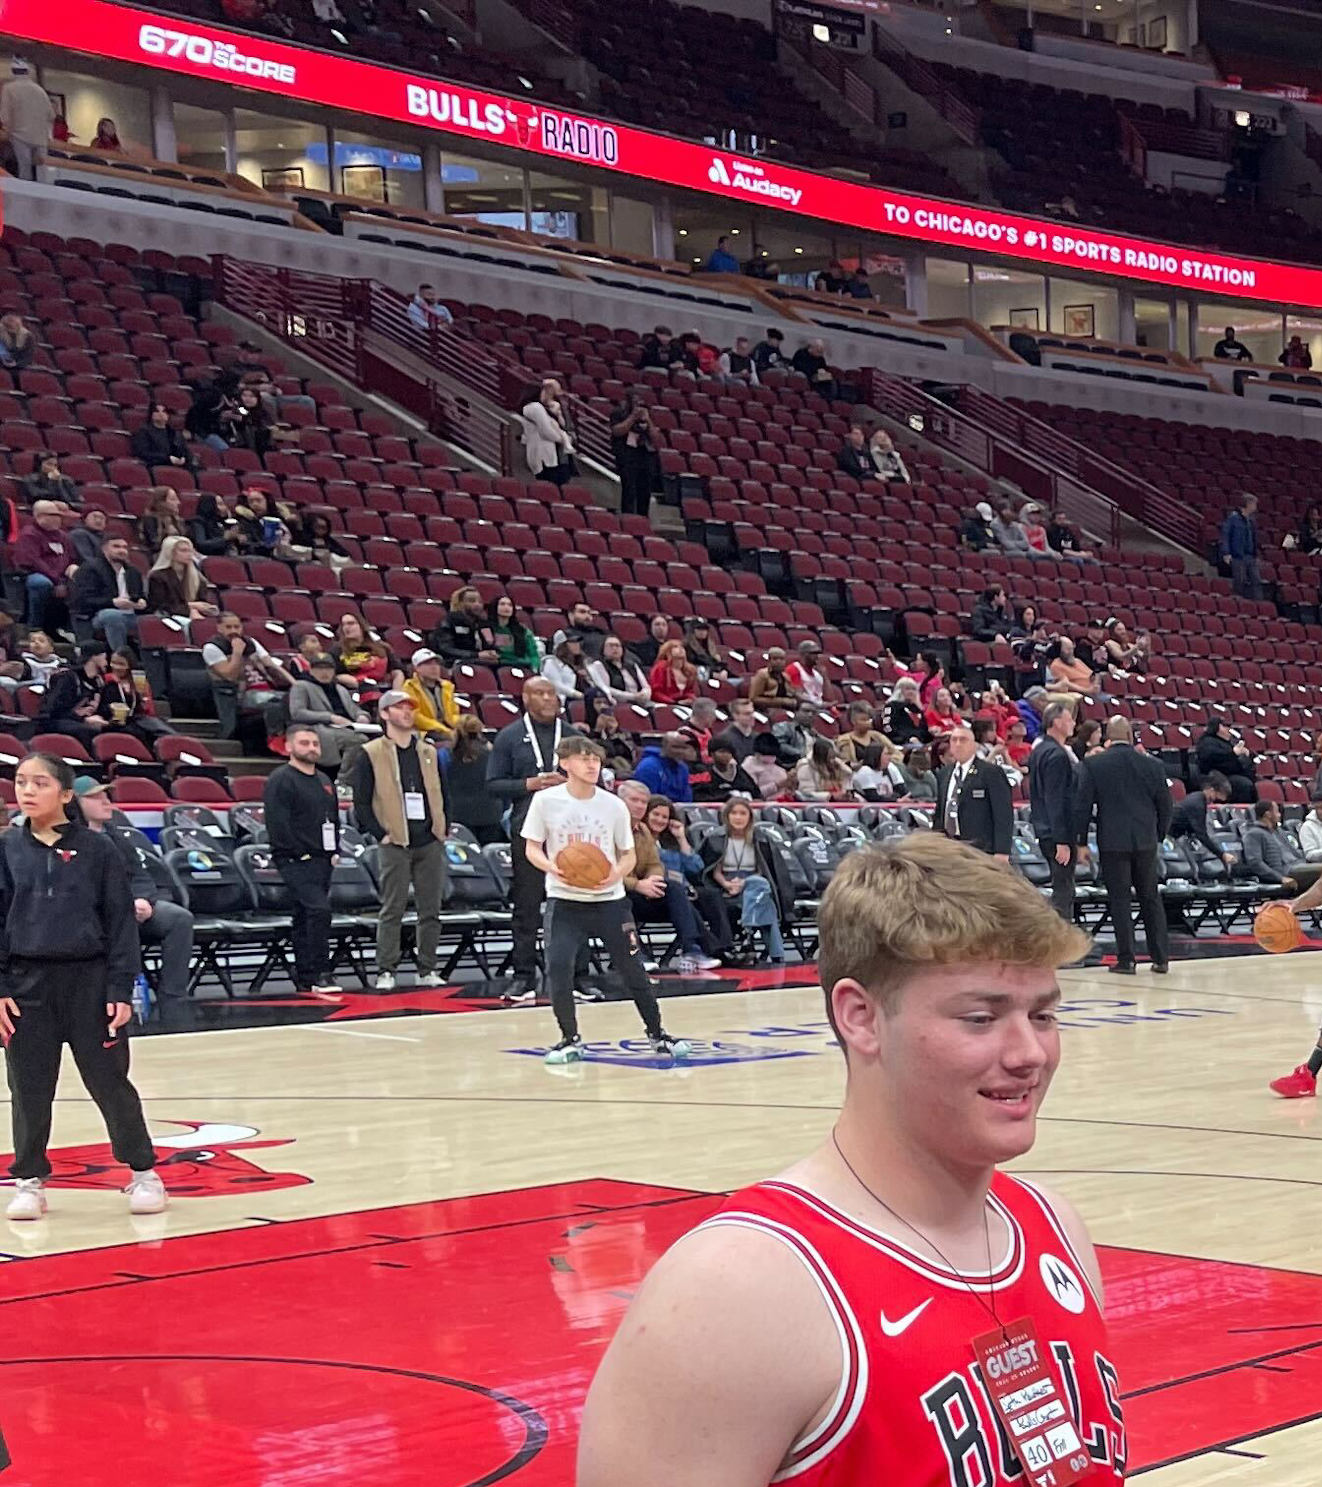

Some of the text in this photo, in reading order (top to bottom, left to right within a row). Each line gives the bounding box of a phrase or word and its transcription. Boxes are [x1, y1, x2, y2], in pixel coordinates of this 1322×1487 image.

[138, 24, 213, 63] 670
[212, 51, 296, 84] SCORE
[407, 84, 618, 165] BULLS RADIO
[732, 172, 802, 205] Audacy
[884, 203, 1256, 287] TO CHICAGO'S #1 SPORTS RADIO STATION
[986, 1340, 1039, 1379] GUEST
[1028, 1444, 1048, 1465] 40
